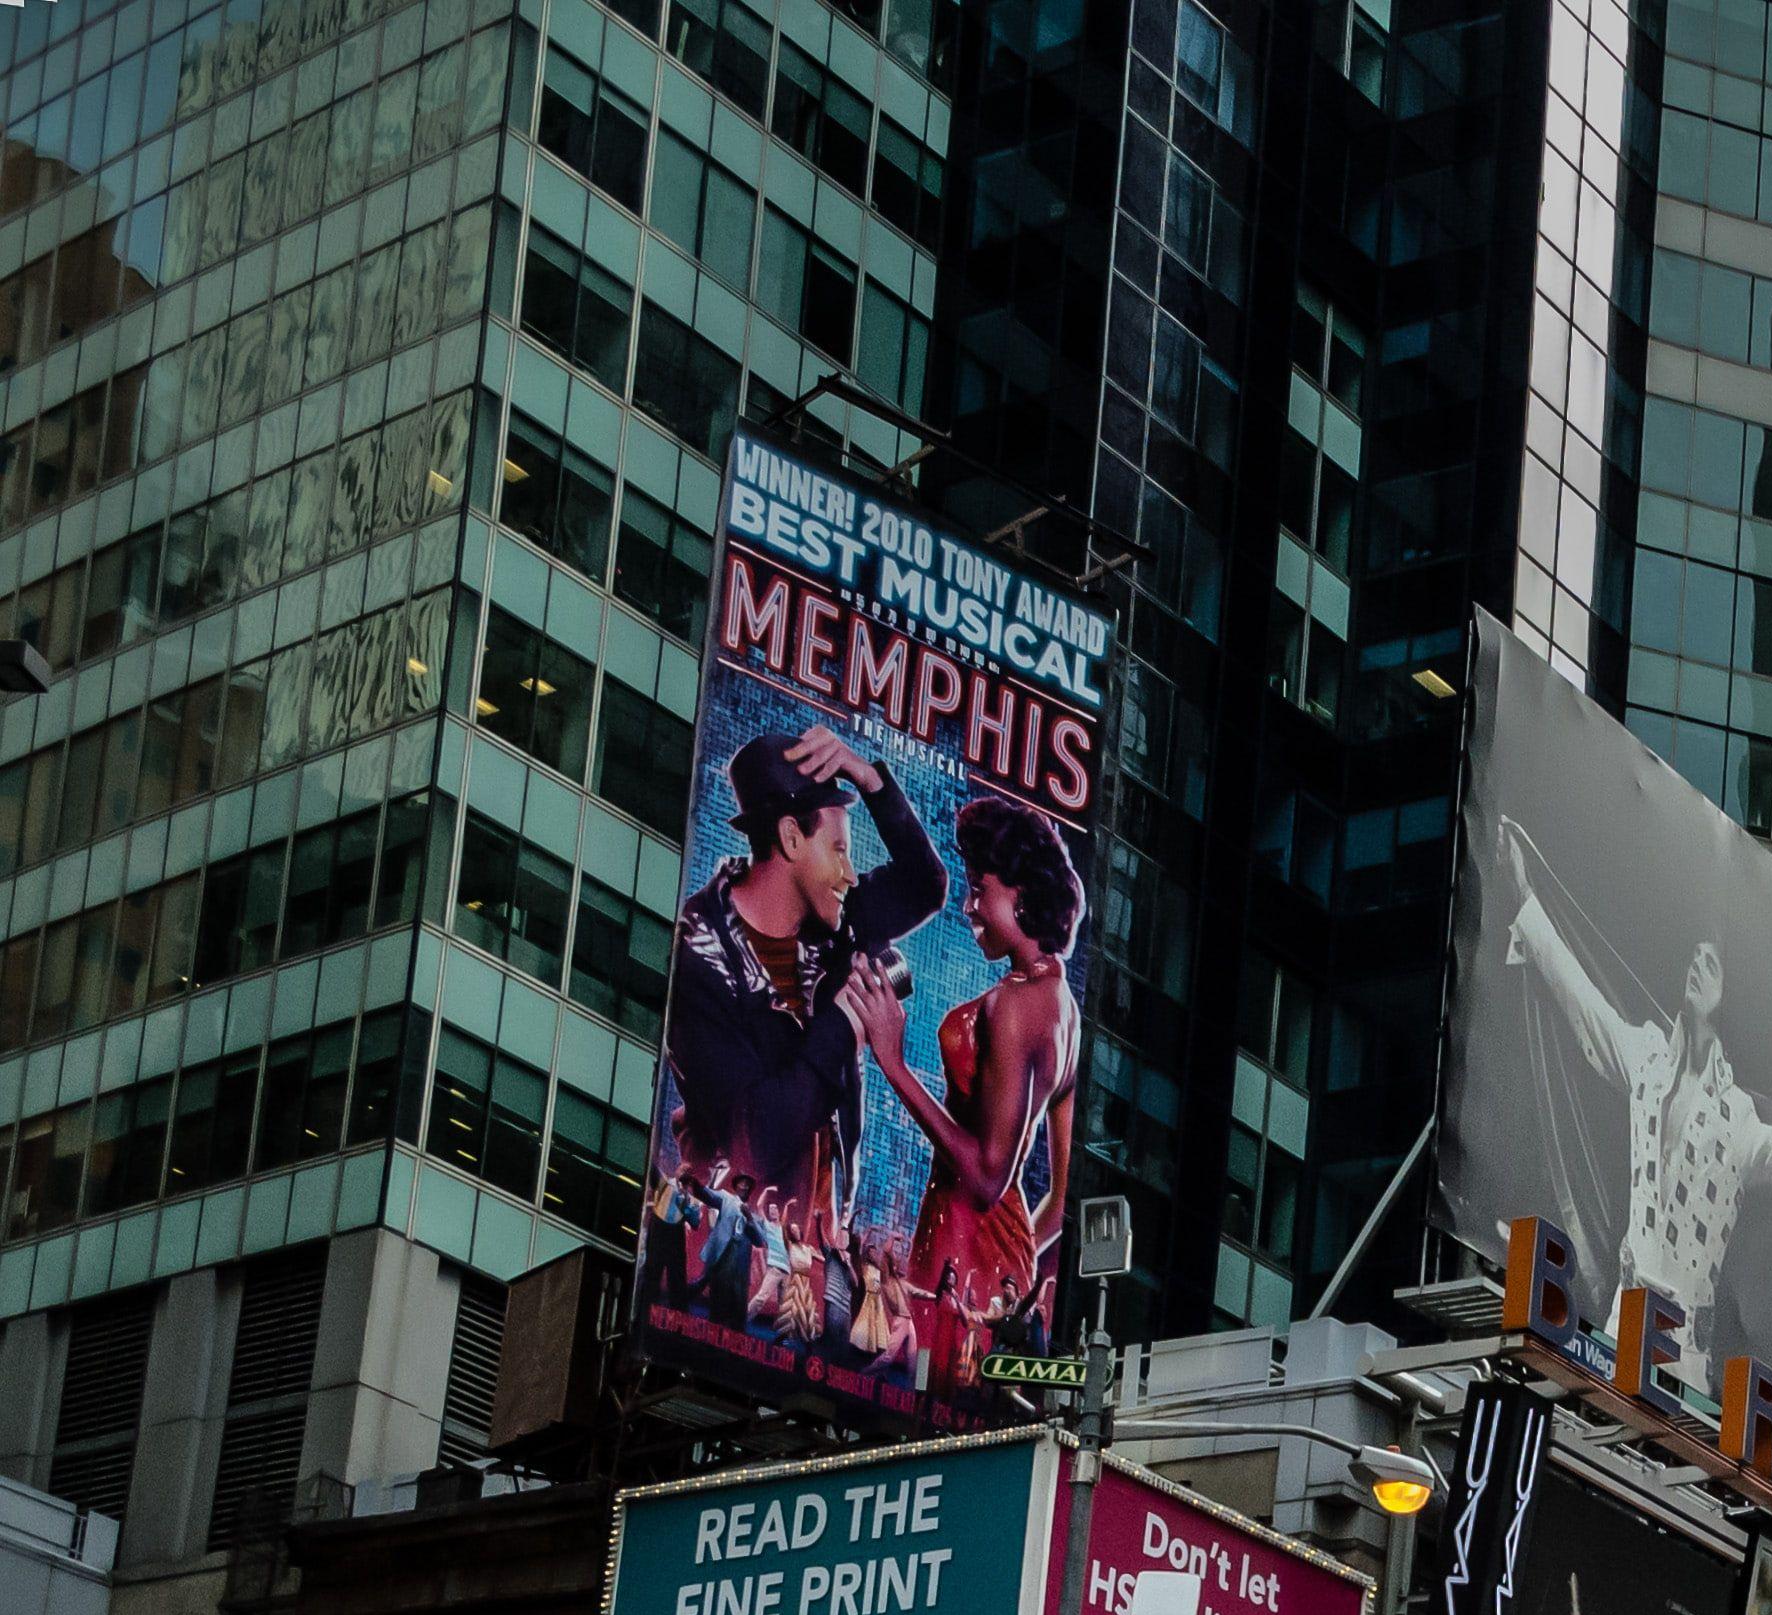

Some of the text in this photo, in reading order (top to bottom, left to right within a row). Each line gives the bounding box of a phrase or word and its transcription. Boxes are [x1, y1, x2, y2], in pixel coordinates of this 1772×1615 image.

[730, 481, 865, 581] BEST
[880, 560, 1100, 705] MUSICAL
[736, 437, 855, 532] WINNER!
[862, 503, 932, 569] 2010
[939, 538, 1011, 607] TONY
[1015, 580, 1106, 656] AWARD
[725, 559, 1092, 808] MEMPHIS
[695, 1474, 943, 1564] READ THE
